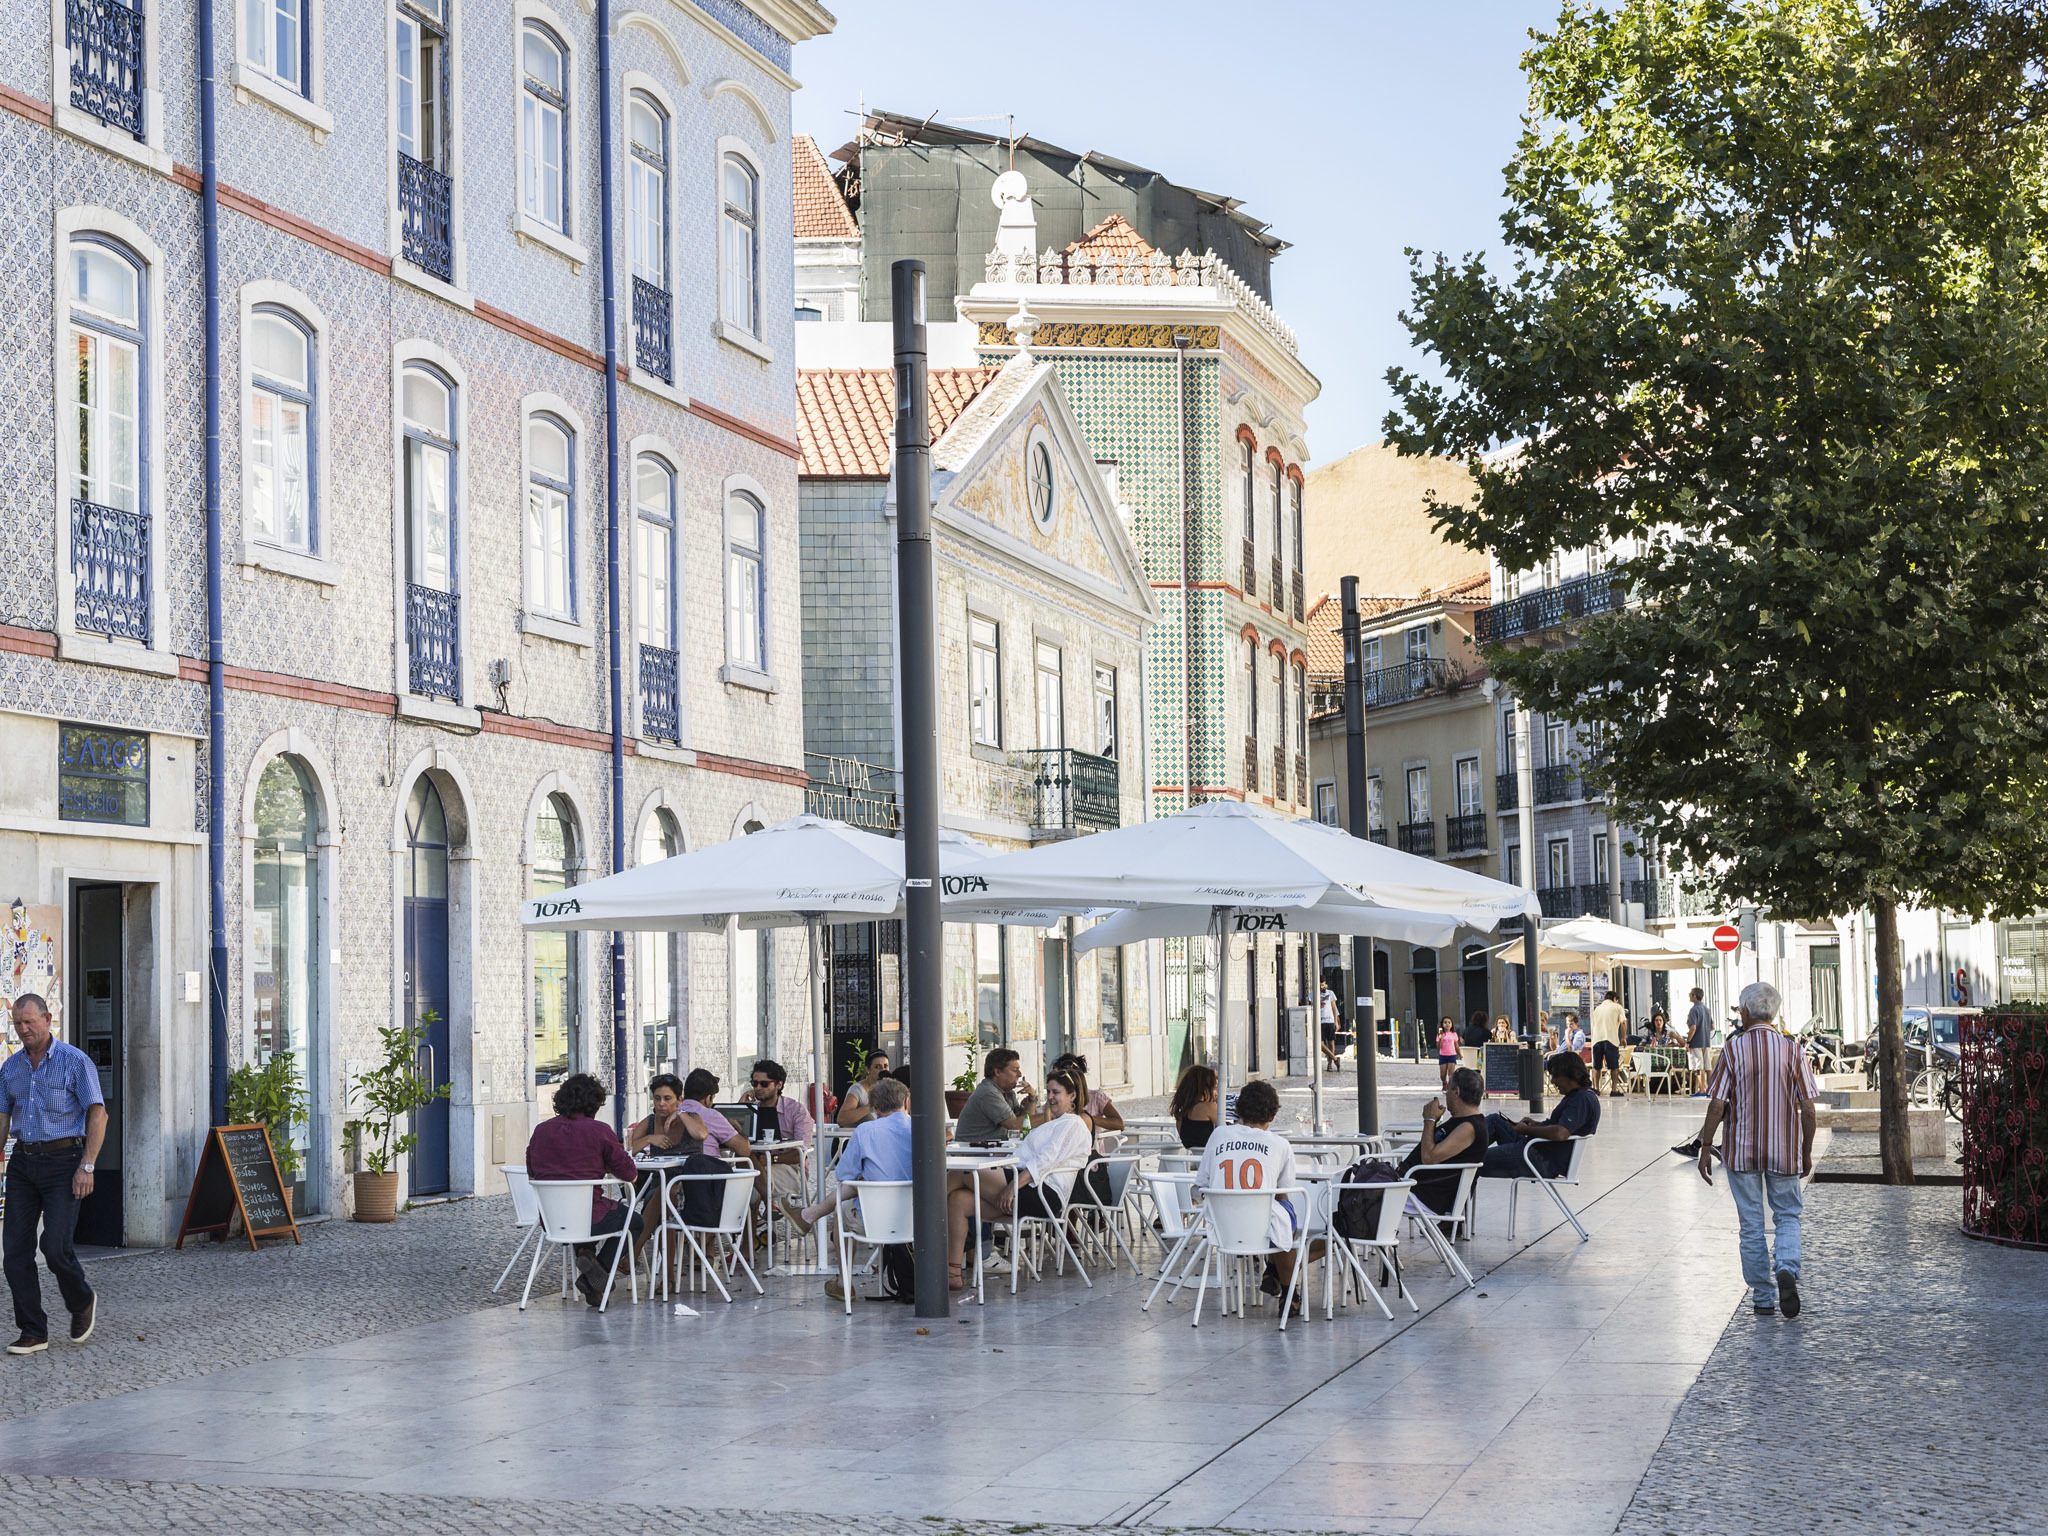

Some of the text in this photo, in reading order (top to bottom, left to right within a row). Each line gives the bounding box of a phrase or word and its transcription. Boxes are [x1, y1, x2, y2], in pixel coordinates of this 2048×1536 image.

[63, 735, 143, 770] LARGO
[839, 757, 871, 791] VIDA
[63, 788, 118, 813] Estúdio
[808, 787, 897, 829] PORTUGUESA
[939, 875, 989, 895] TOFA
[532, 898, 584, 918] TOFA
[833, 892, 850, 904] que
[857, 893, 885, 902] nosso.
[1000, 909, 1016, 920] que
[1023, 911, 1048, 919] nosso.
[1233, 913, 1288, 931] TOFA
[1215, 1140, 1269, 1156] LE FLOROINE
[1219, 1158, 1263, 1189] 10
